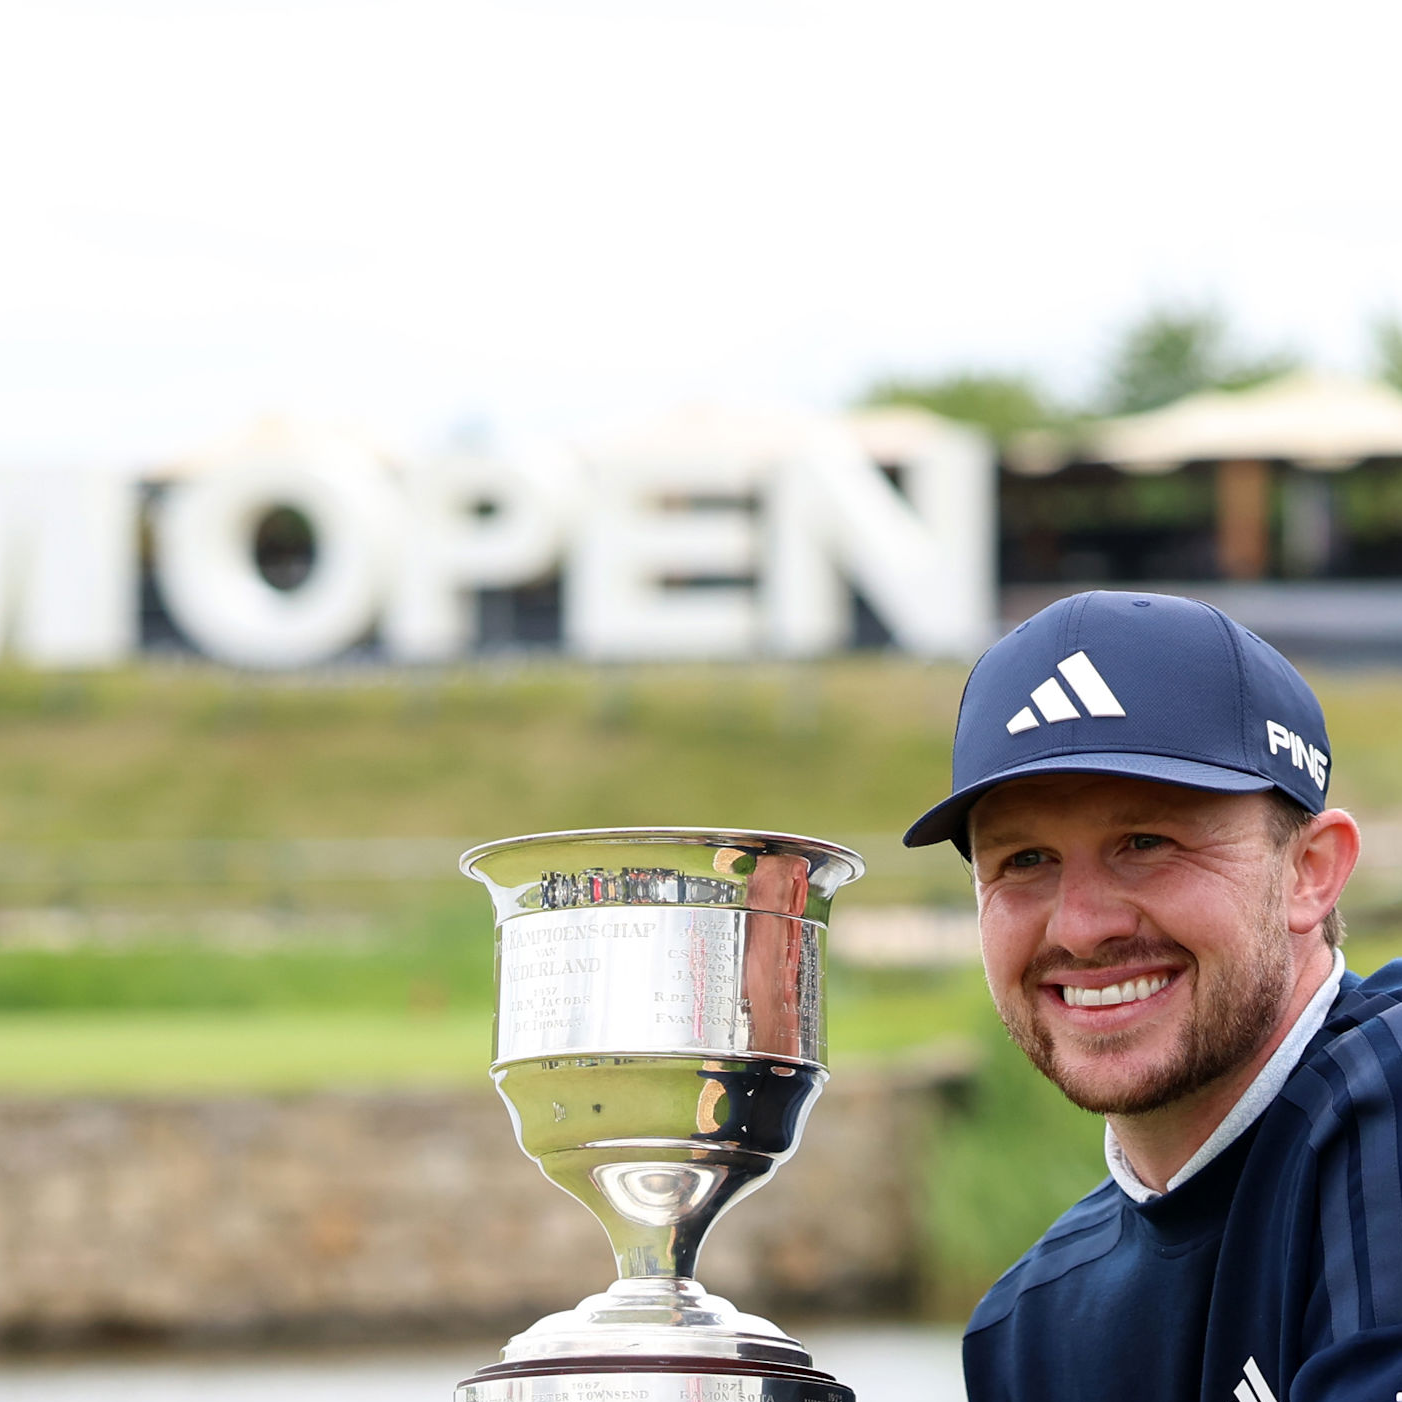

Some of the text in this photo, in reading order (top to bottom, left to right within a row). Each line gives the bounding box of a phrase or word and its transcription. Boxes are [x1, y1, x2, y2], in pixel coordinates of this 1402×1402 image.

[158, 422, 996, 668] OPEN
[1266, 720, 1329, 792] PING
[577, 1389, 650, 1402] TOWNSEND
